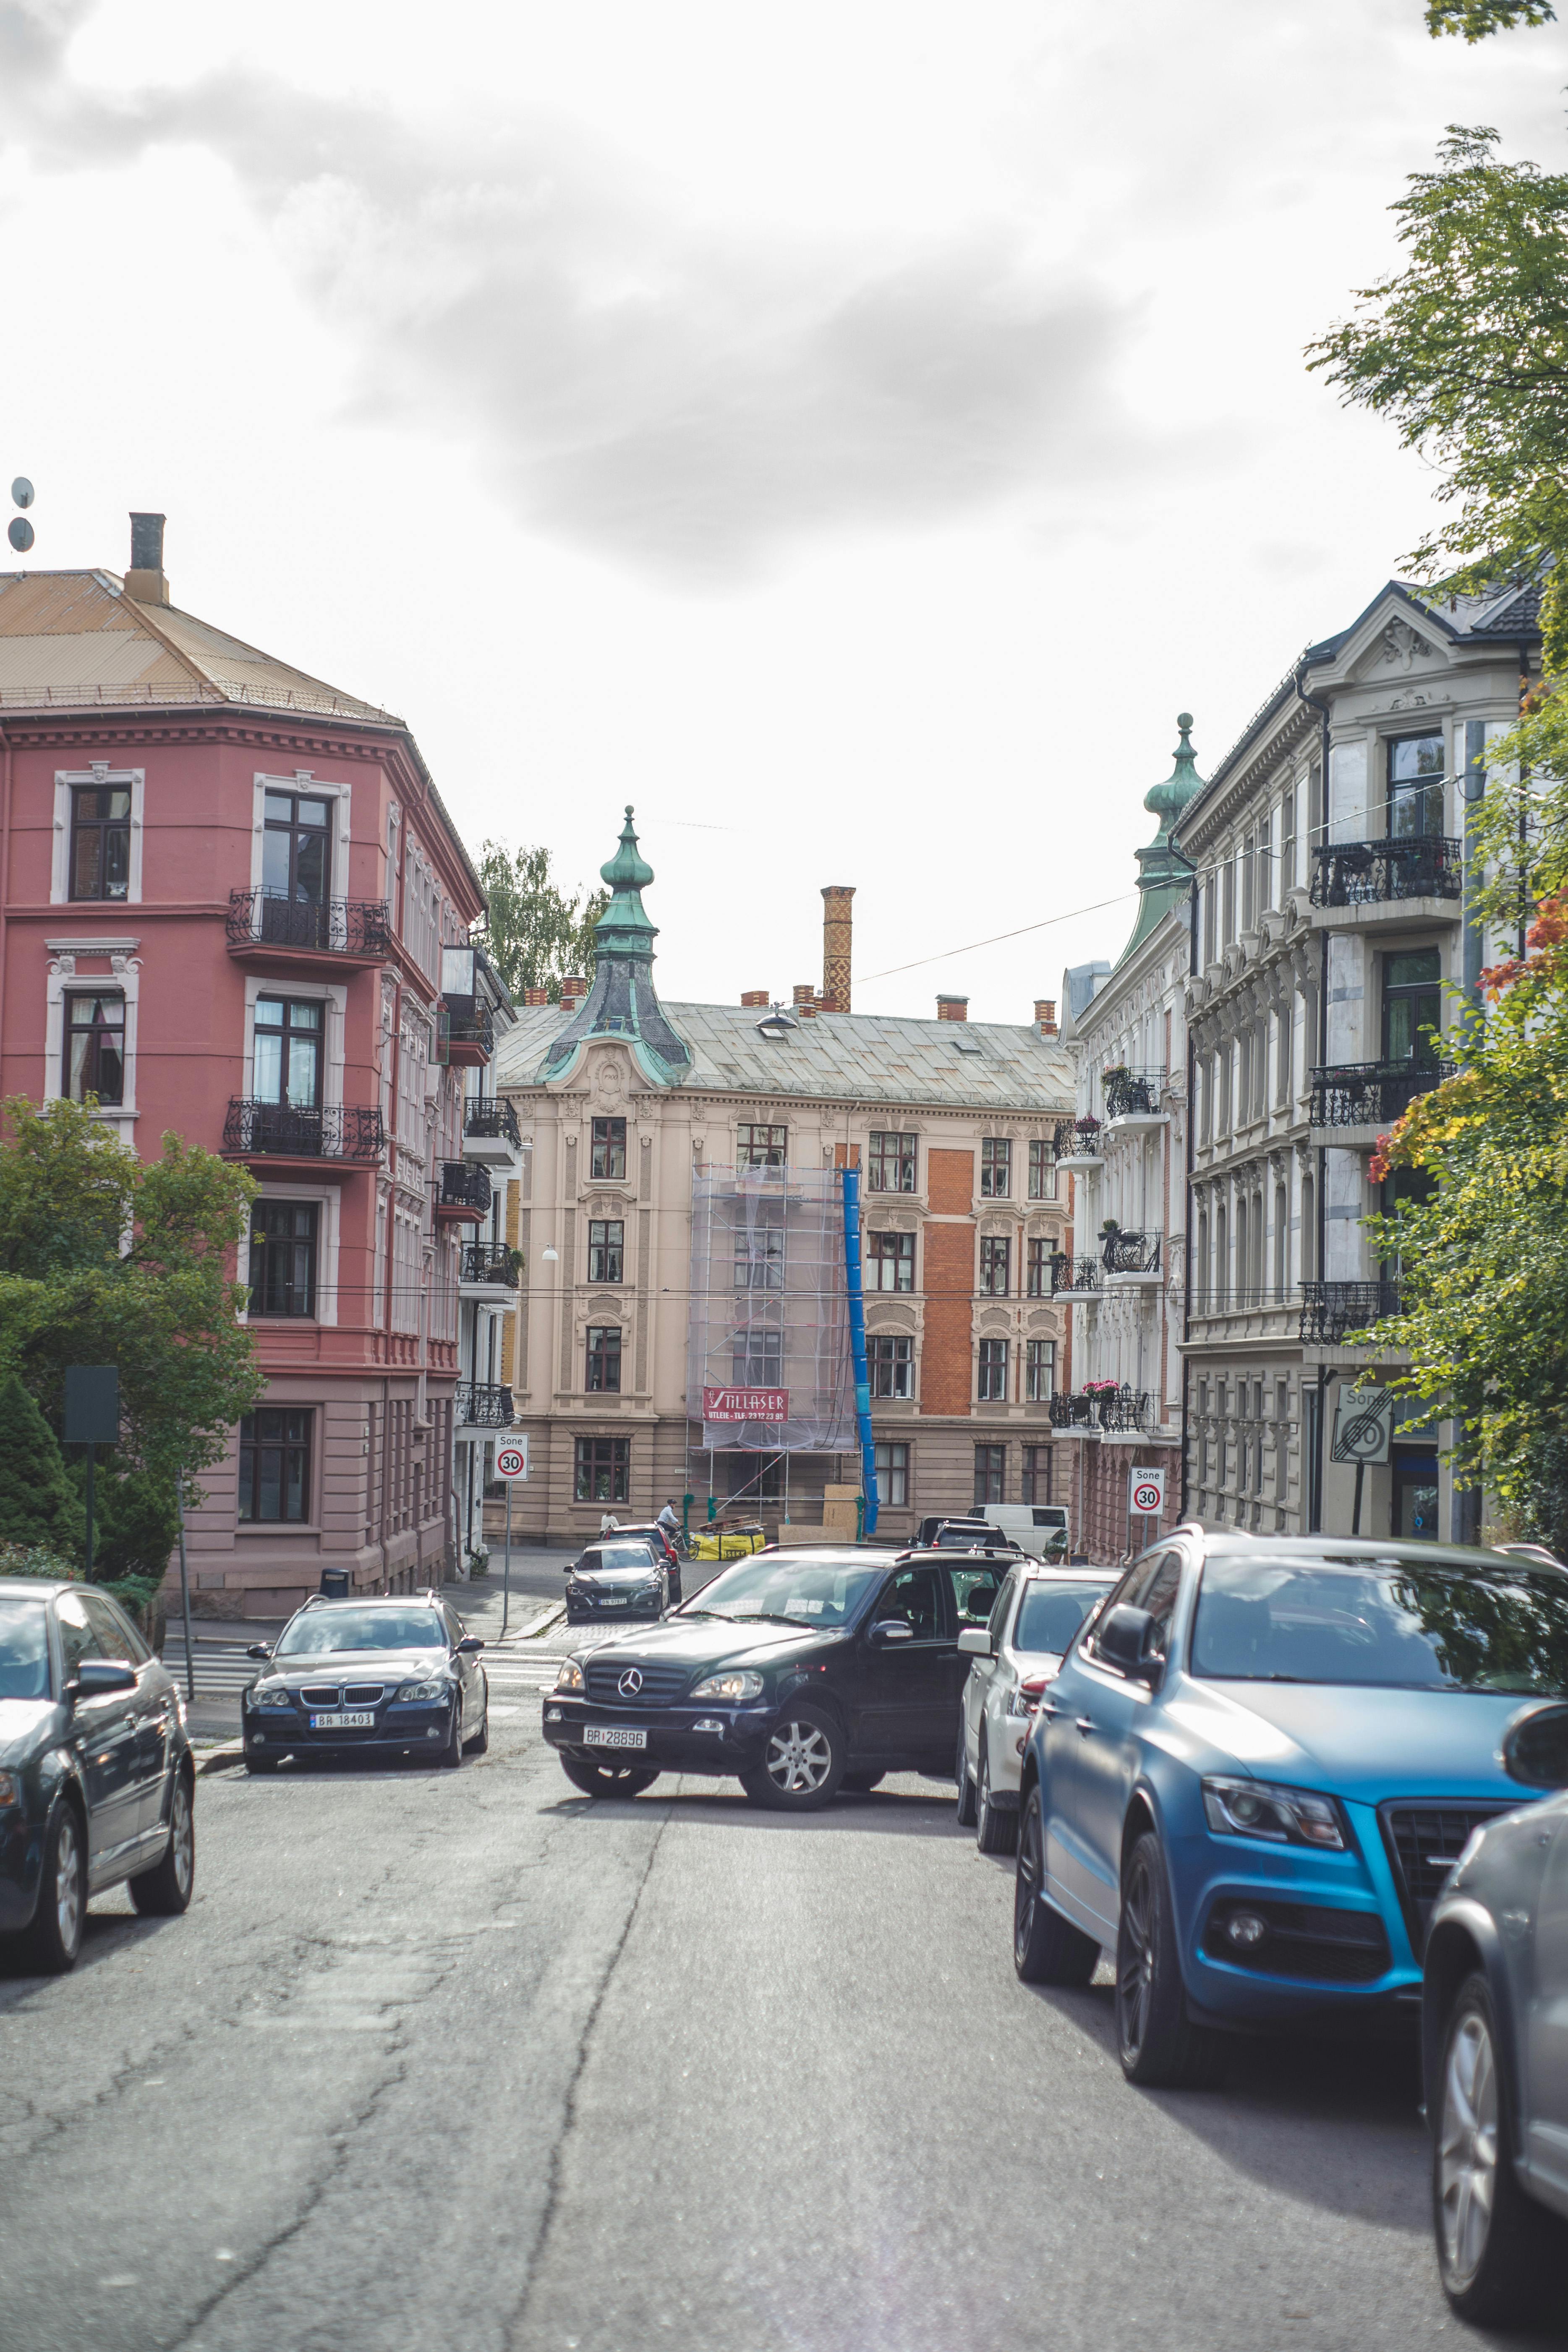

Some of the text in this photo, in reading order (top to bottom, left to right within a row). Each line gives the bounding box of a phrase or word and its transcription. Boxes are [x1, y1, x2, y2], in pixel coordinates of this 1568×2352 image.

[500, 1437, 523, 1445] Sone
[503, 1456, 519, 1469] 30
[1137, 1471, 1160, 1479] Sone
[1139, 1491, 1155, 1504] 30
[319, 1715, 333, 1726] BR
[587, 1730, 643, 1746] BR 28896
